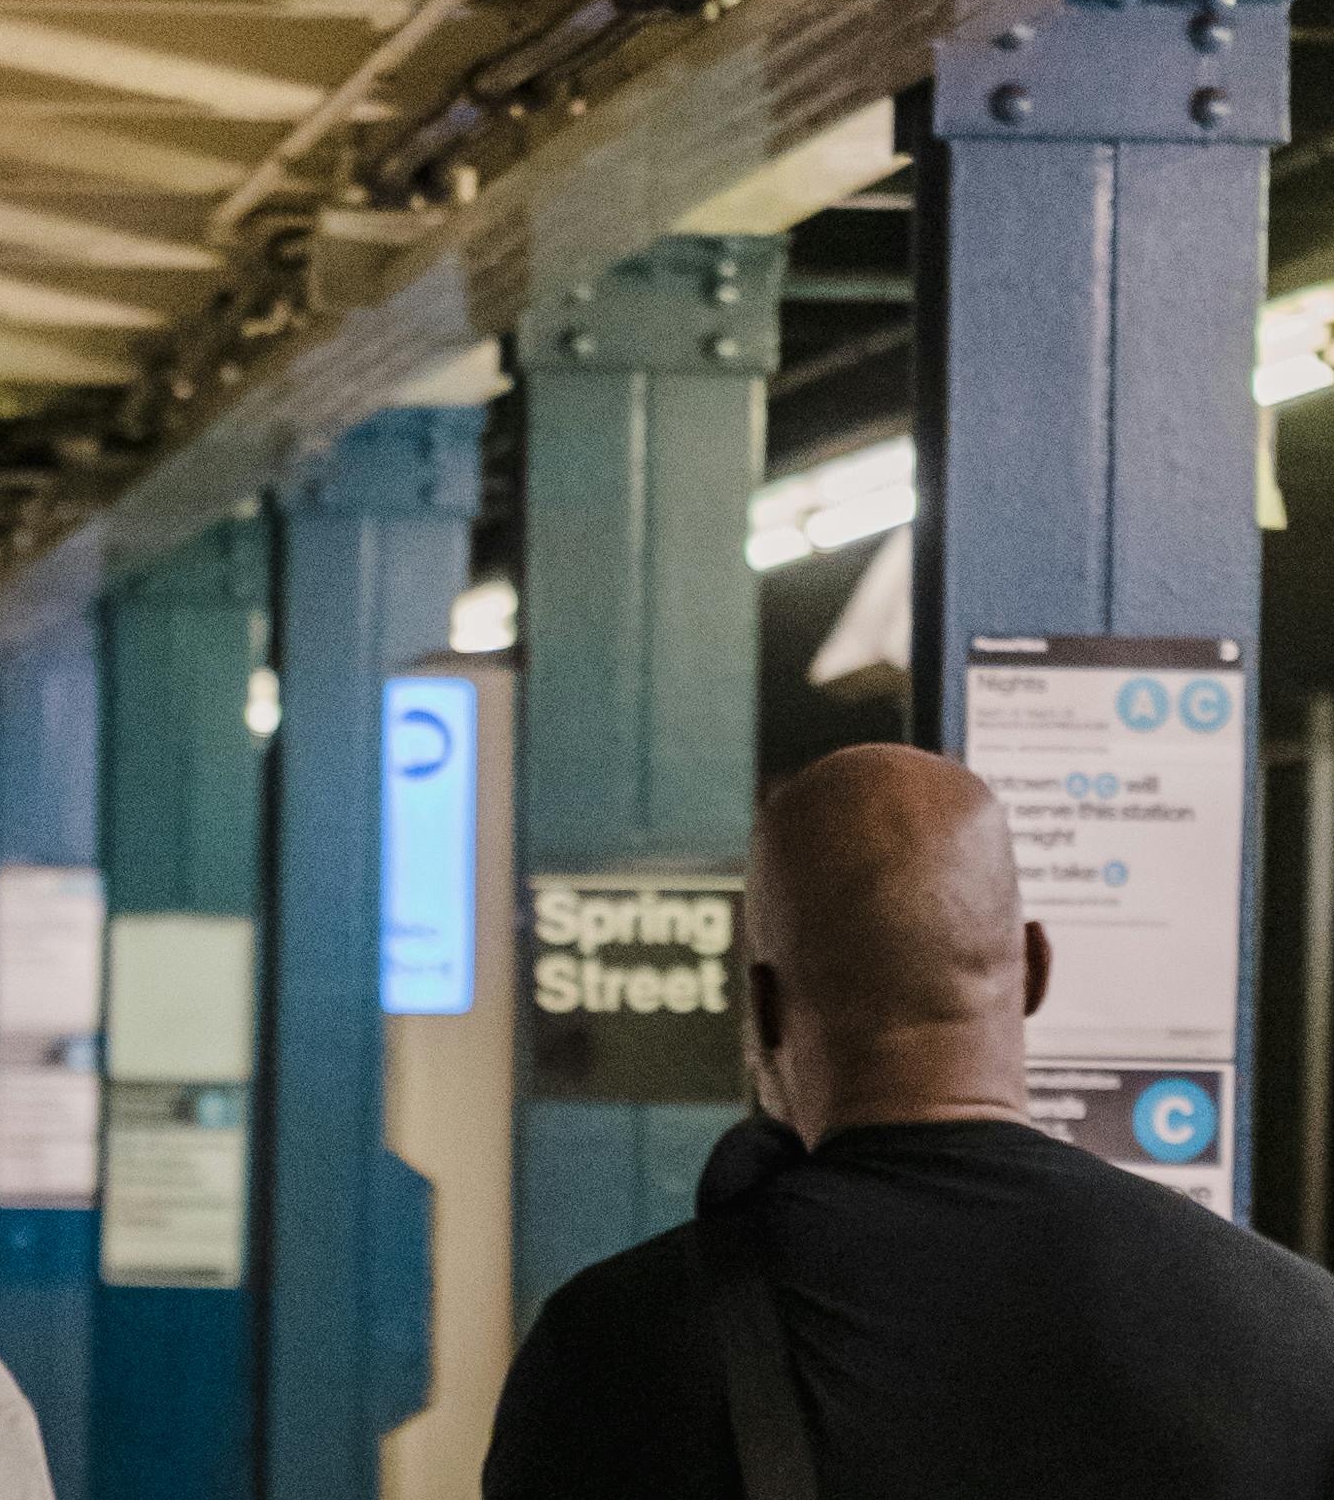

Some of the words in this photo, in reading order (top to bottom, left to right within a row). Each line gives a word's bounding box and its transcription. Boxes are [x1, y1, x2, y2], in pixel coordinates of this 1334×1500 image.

[535, 885, 732, 955] Spring
[535, 953, 728, 1014] Street
[1152, 1096, 1195, 1144] C
